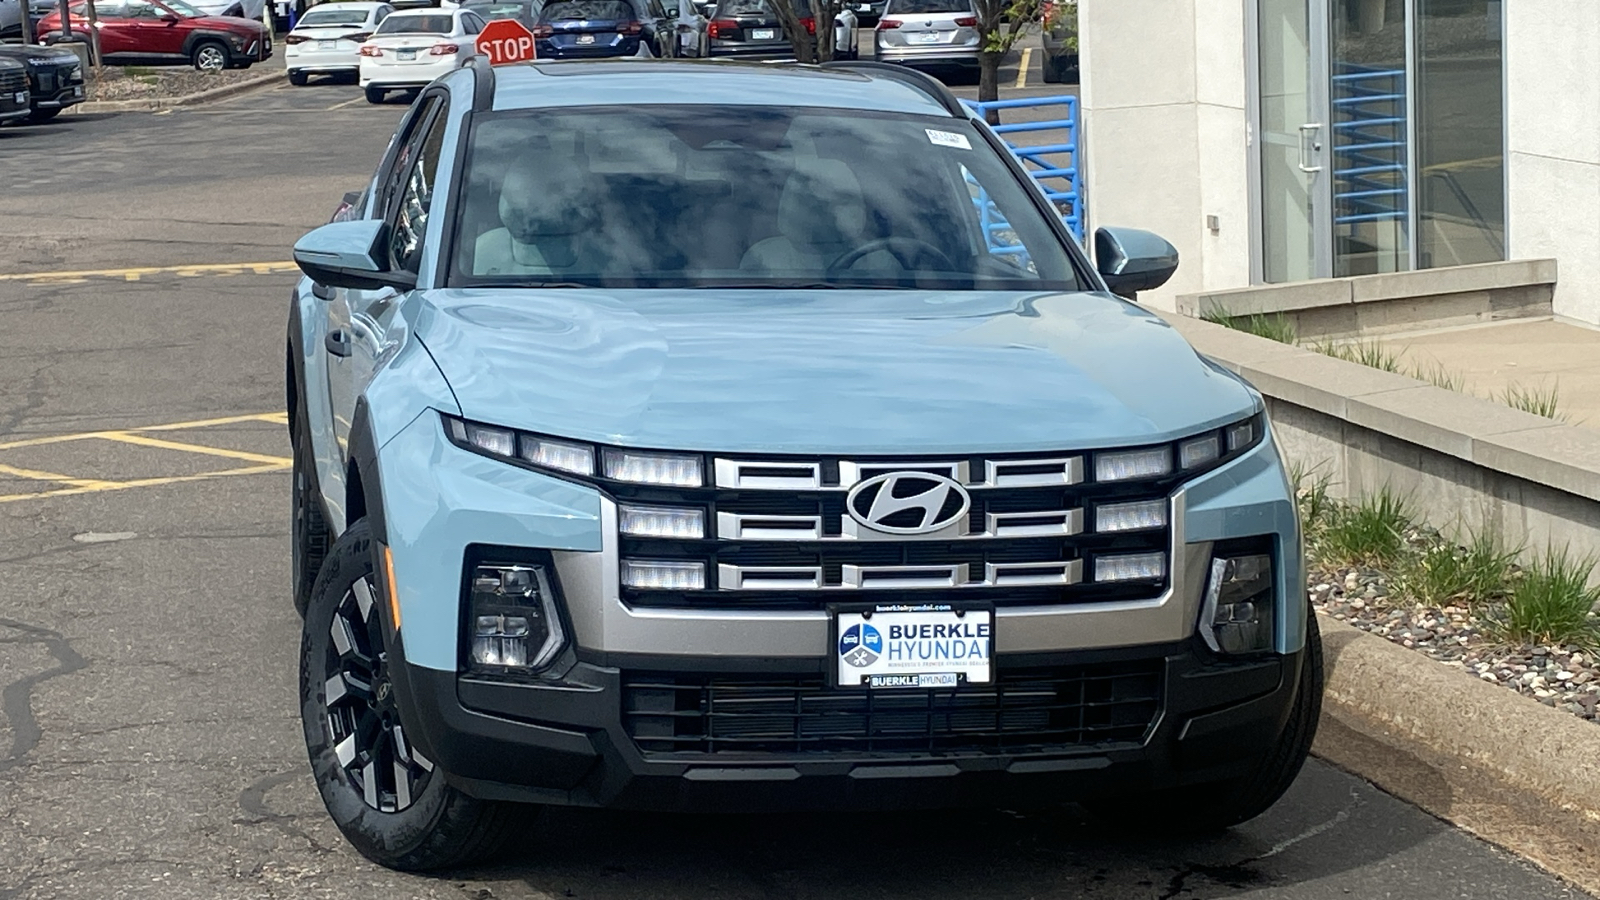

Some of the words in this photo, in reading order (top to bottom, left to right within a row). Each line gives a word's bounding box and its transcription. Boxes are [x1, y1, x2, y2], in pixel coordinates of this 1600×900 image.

[480, 37, 531, 61] STOP
[889, 624, 989, 640] BUERKLE
[888, 640, 989, 661] HYUNDAI
[872, 676, 918, 687] BUERKLE
[920, 675, 955, 685] HYUNDAI
